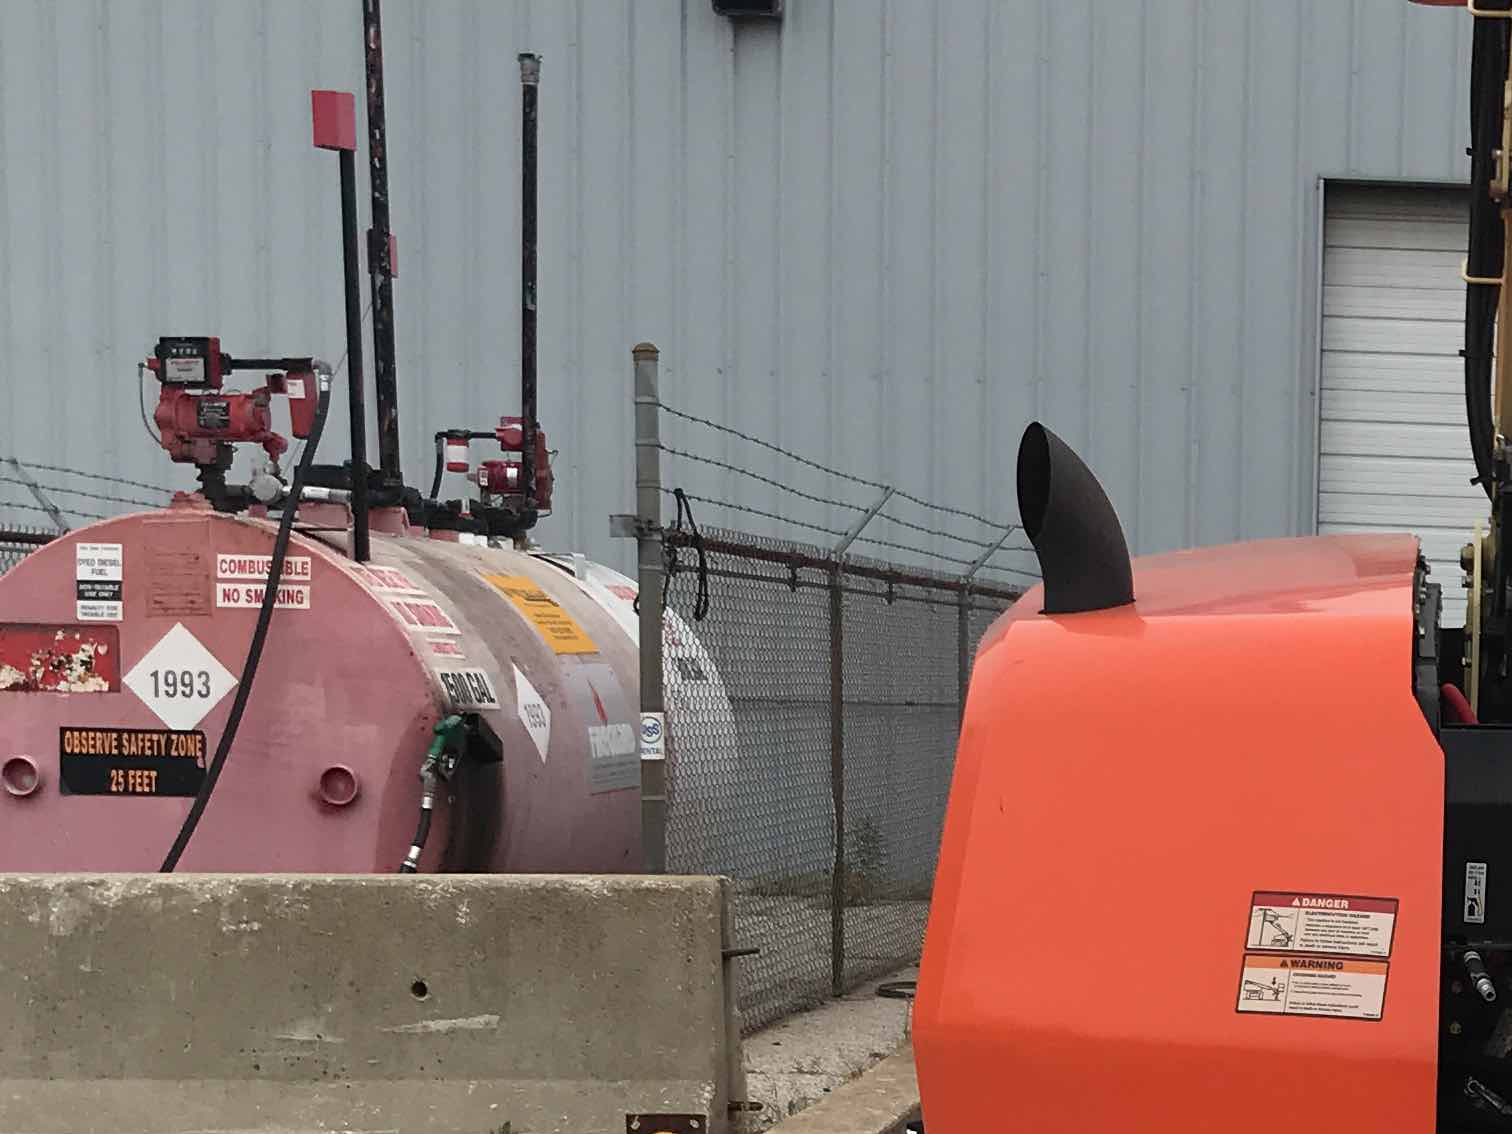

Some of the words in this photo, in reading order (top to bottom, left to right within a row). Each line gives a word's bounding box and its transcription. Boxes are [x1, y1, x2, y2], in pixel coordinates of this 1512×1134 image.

[219, 559, 309, 576] COMBUSBLE
[222, 588, 241, 604] NO
[245, 588, 304, 605] SMKING
[150, 670, 211, 699] 1993
[64, 730, 118, 755] OBSERVE
[122, 733, 167, 757] SAFETY
[171, 734, 204, 759] ZONE
[110, 769, 125, 792] 25
[128, 770, 158, 793] FEET
[1302, 897, 1349, 909] DANGER
[1290, 959, 1344, 970] WARNING
